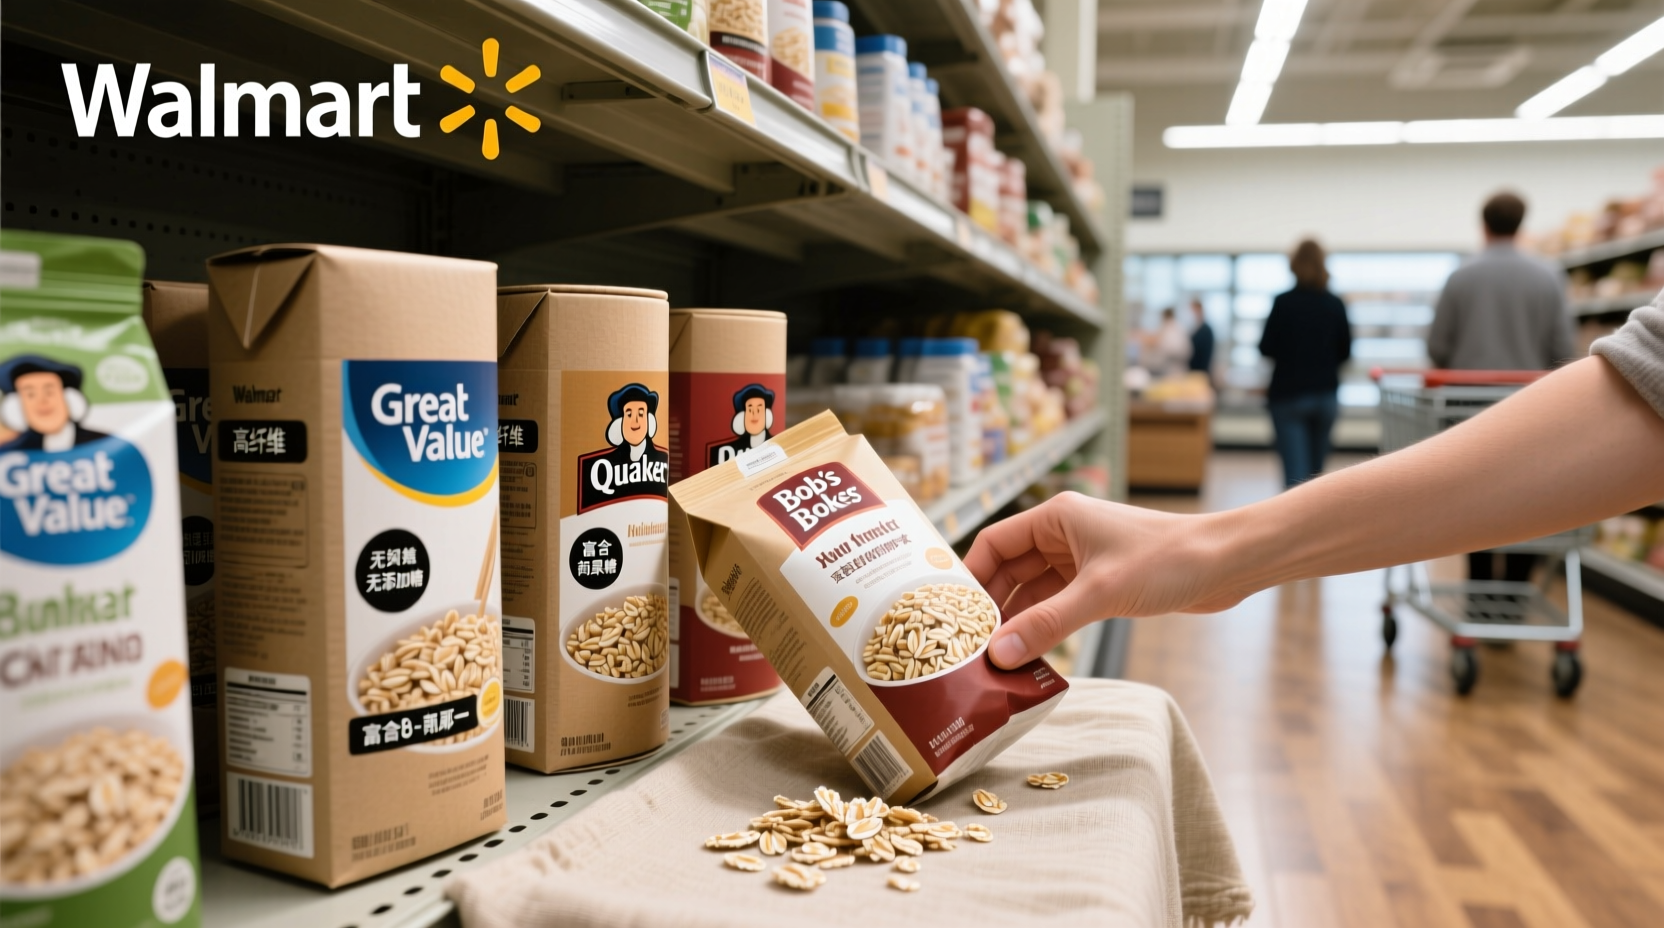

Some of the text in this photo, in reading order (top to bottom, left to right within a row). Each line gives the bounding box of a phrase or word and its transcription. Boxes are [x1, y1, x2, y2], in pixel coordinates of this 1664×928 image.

[371, 383, 469, 426] Great
[402, 423, 486, 463] Value
[0, 451, 116, 499] Great
[591, 454, 668, 495] Quaker
[773, 471, 842, 512] Bob's
[13, 491, 129, 536] Value
